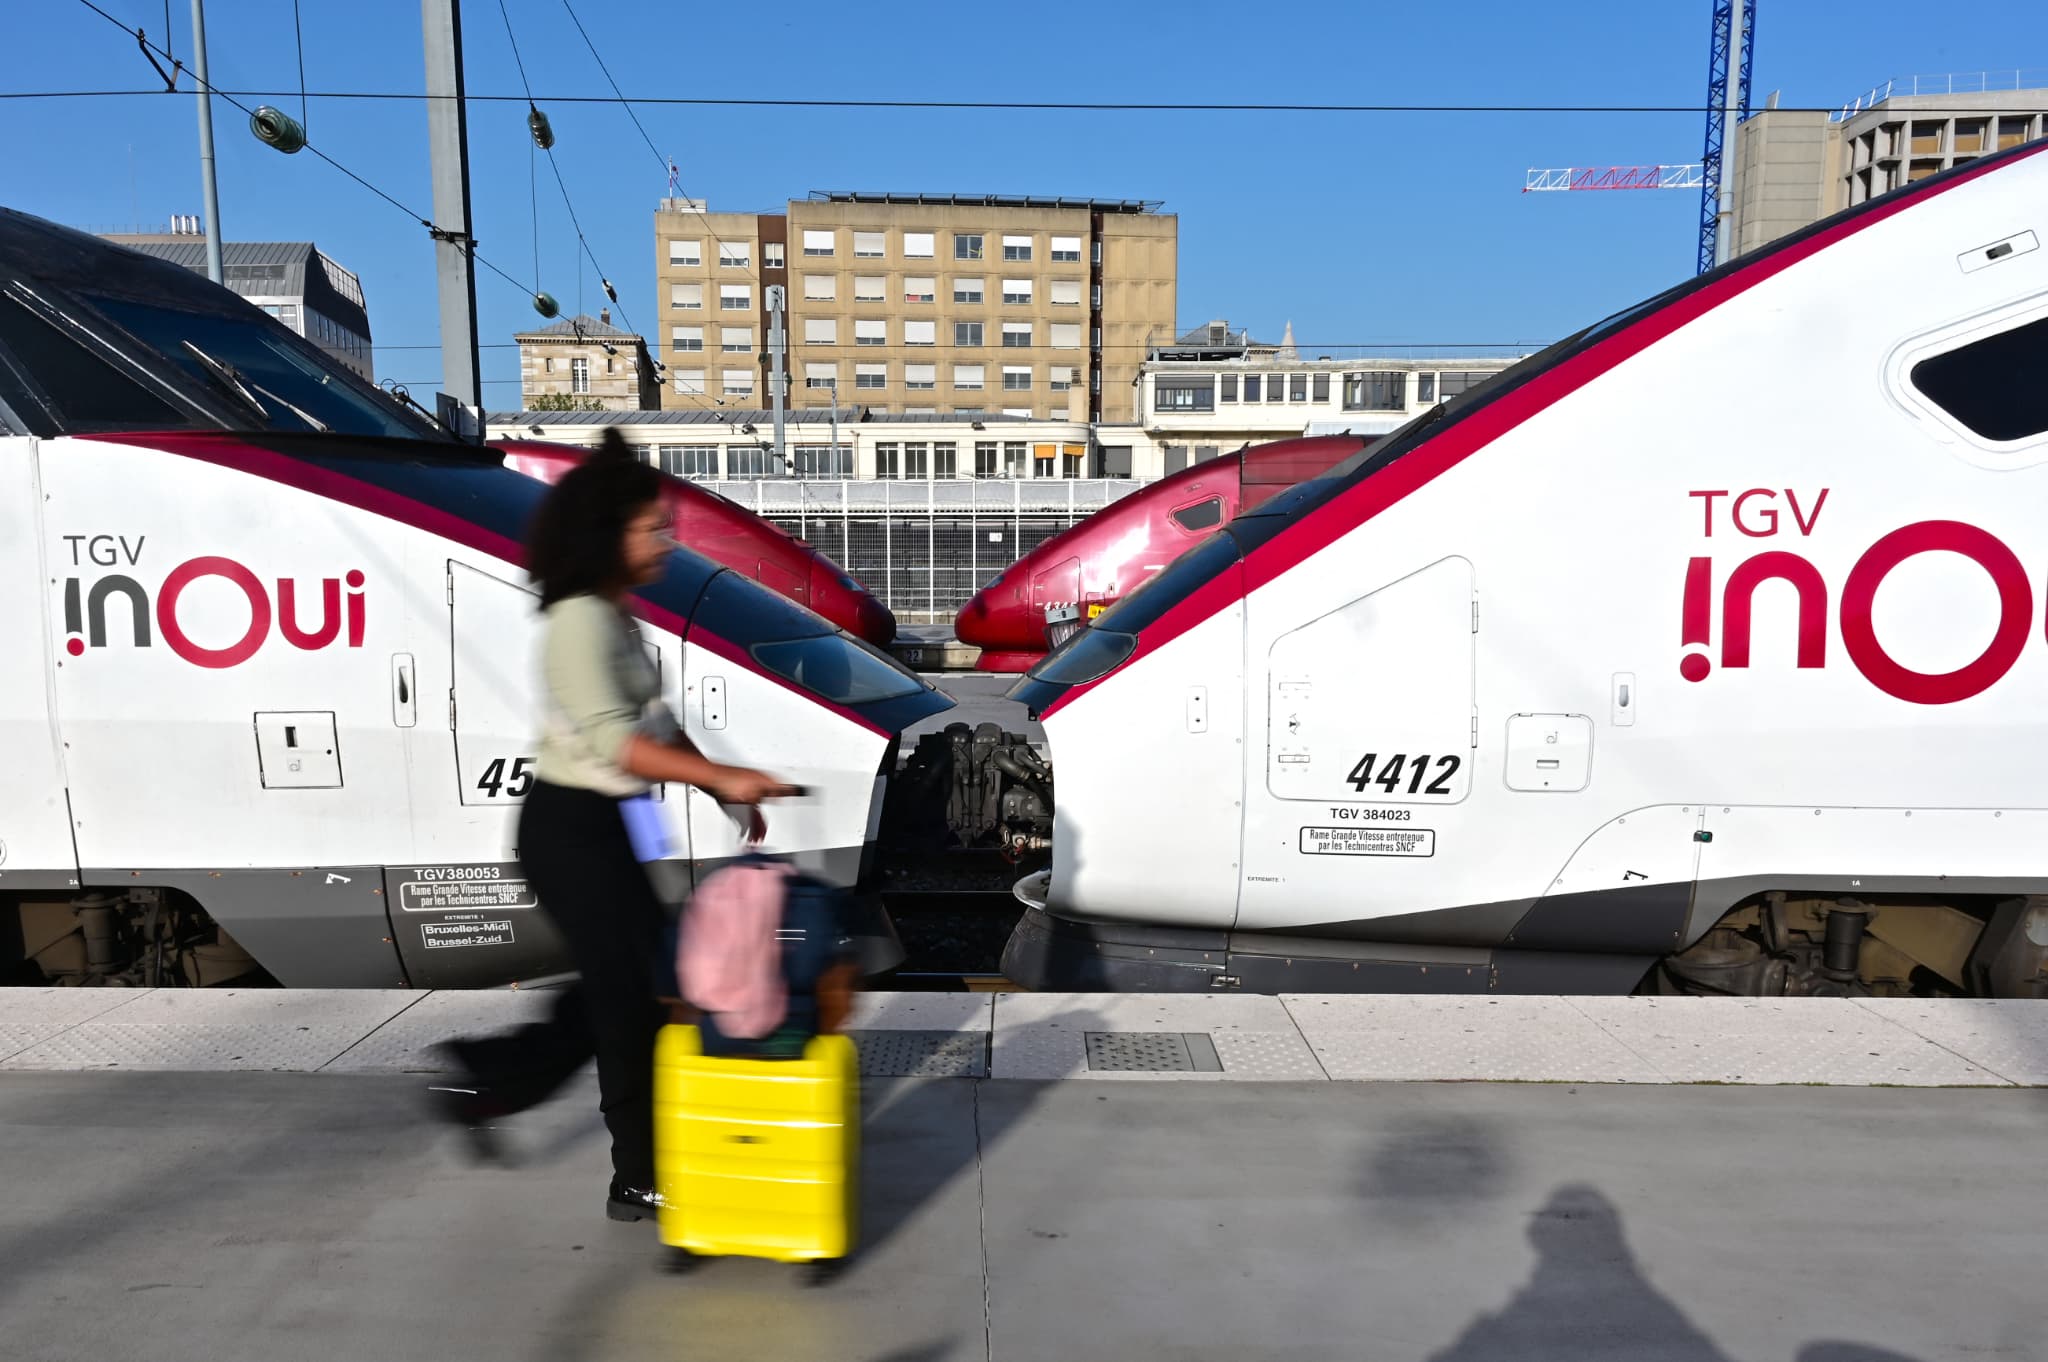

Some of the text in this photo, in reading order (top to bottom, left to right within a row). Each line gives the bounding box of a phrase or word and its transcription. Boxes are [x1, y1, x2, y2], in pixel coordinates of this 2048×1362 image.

[1689, 487, 1830, 538] TGV
[63, 535, 145, 566] TGV
[1679, 519, 2048, 705] inO
[1346, 753, 1461, 795] 4412
[1330, 808, 1411, 821] TGV 384023
[1310, 829, 1425, 842] Rame Grande Vitesse entretenue
[1318, 840, 1416, 853] par les Technicentres SNCF
[414, 867, 500, 880] TGV380053
[410, 883, 527, 896] Rame Grande Vitesse entretenue
[421, 892, 519, 907] par les Technicentres SNCF
[425, 922, 509, 934] Bruxelles-Midi
[427, 935, 502, 947] Brussel-Zuid
